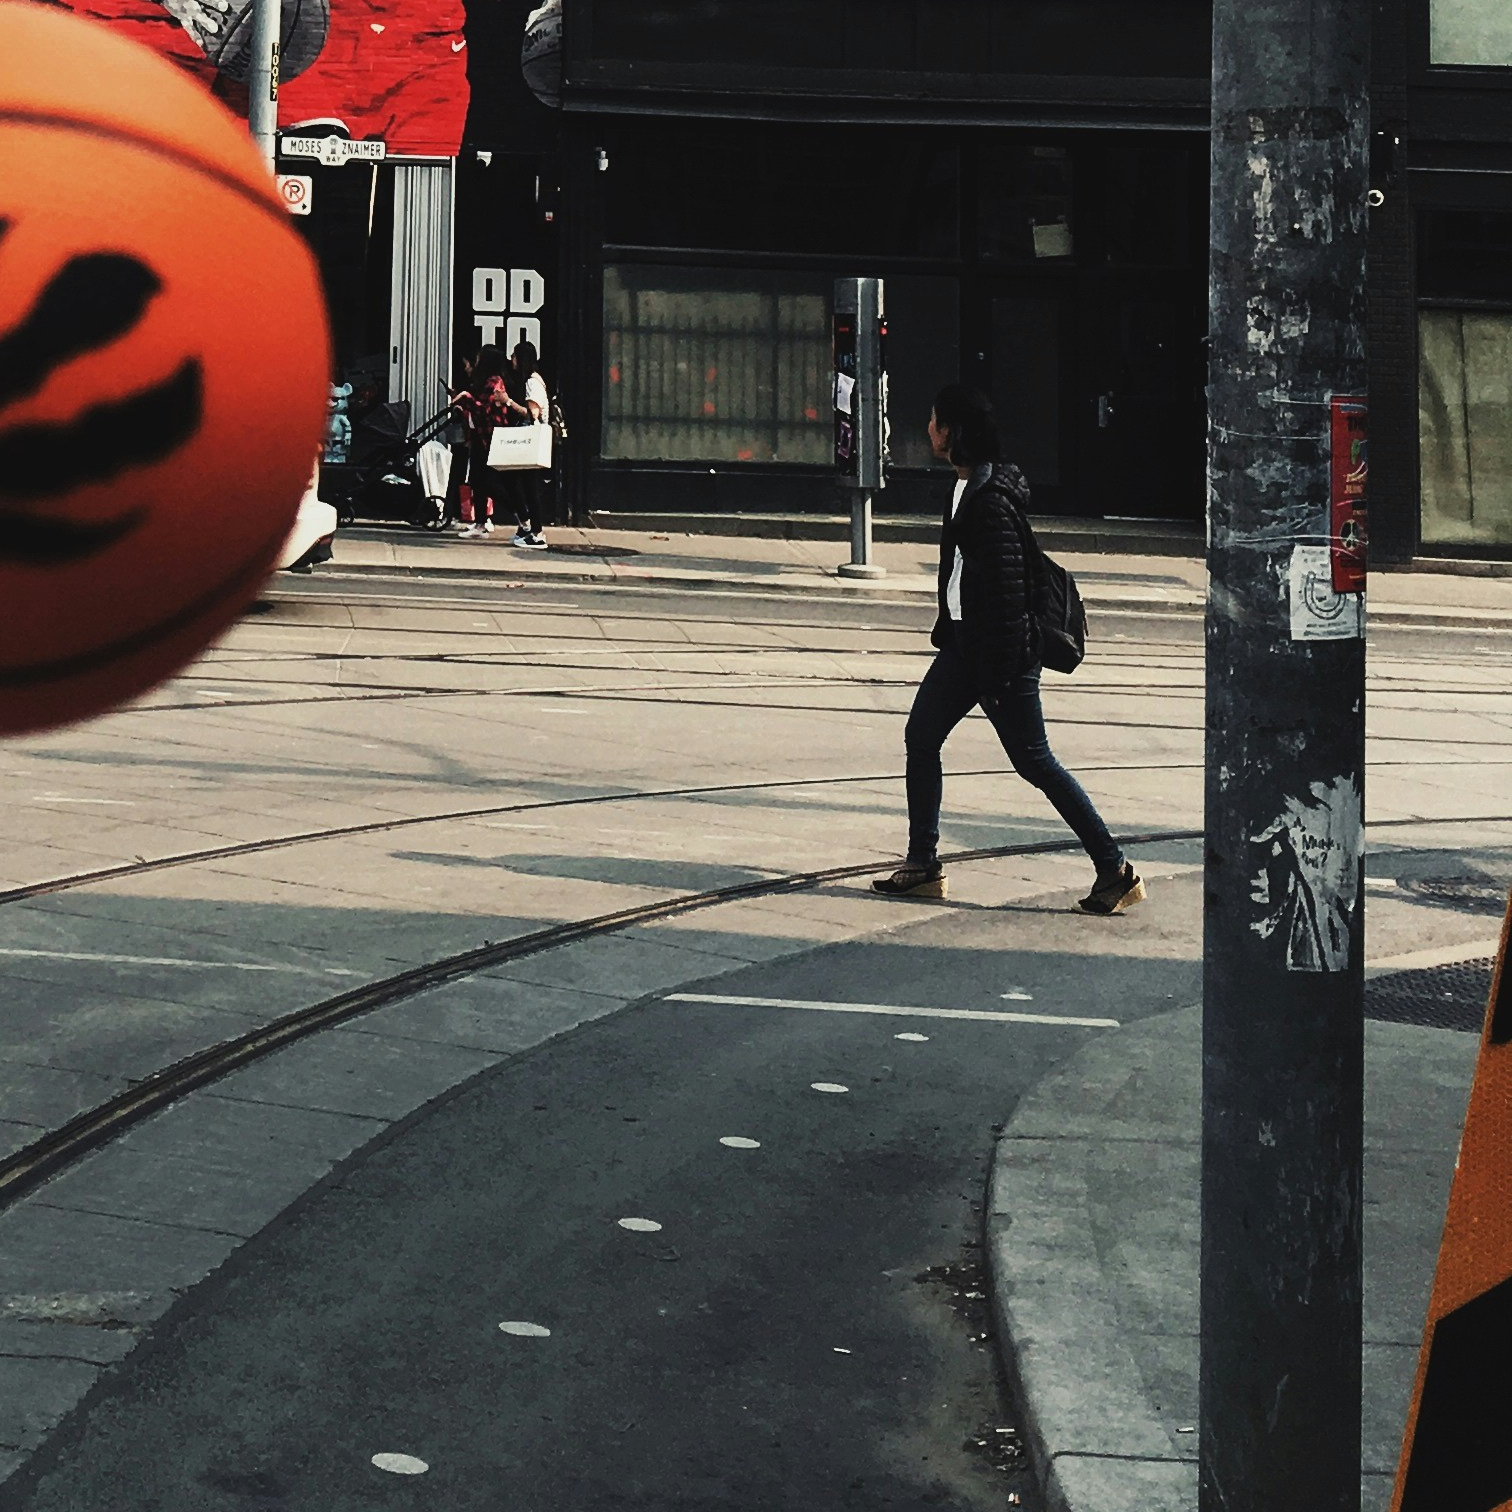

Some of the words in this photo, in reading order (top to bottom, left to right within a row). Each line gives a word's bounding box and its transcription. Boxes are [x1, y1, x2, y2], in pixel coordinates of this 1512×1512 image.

[271, 42, 280, 101] T0067
[290, 140, 322, 153] MOSES
[342, 143, 381, 156] ZNAIMER
[472, 267, 545, 314] OD
